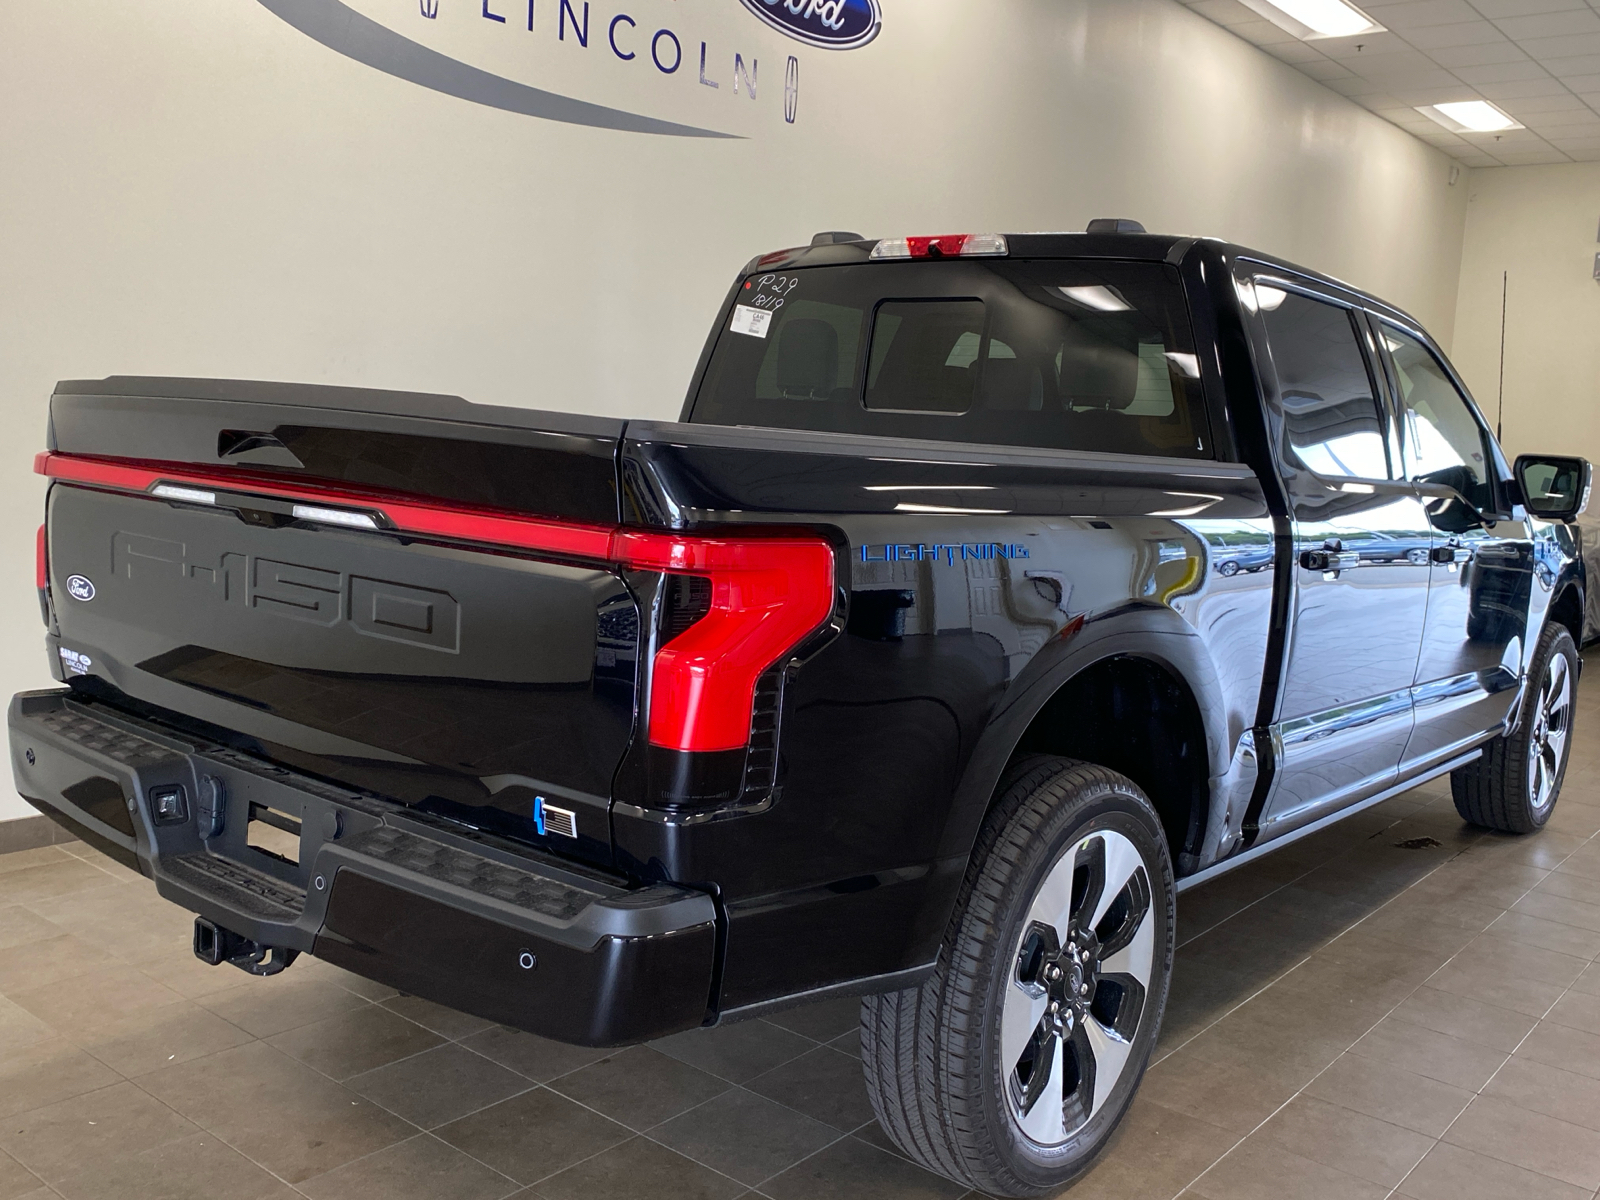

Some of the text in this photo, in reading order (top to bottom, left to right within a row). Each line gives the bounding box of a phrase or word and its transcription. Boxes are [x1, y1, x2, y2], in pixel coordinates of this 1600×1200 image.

[763, 0, 845, 31] ord
[861, 543, 1030, 567] LIGHTNING
[111, 530, 461, 655] F-150
